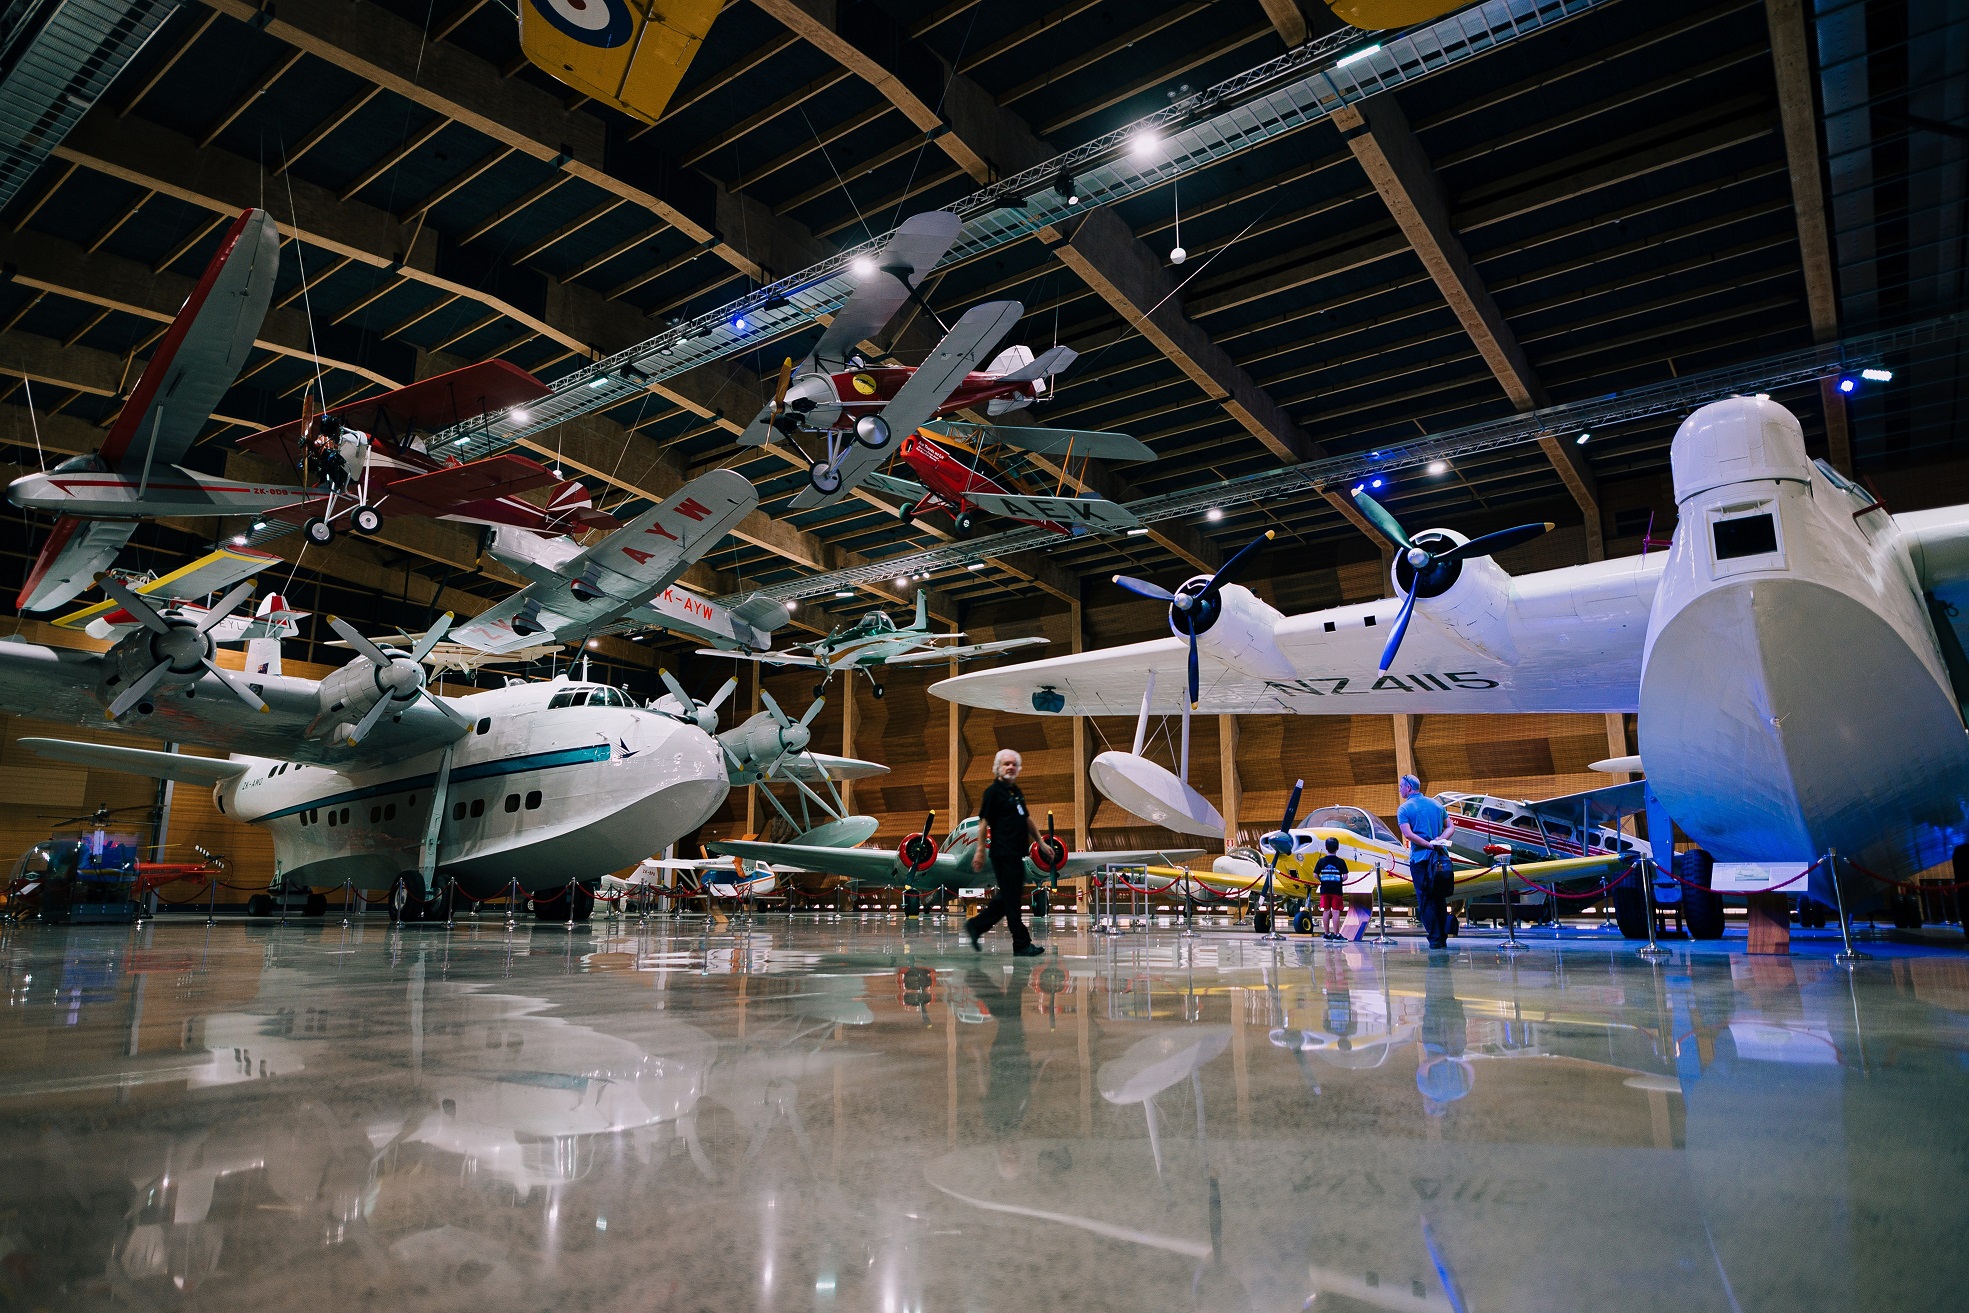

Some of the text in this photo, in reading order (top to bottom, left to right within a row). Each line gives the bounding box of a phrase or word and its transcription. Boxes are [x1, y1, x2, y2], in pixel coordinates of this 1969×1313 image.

[1000, 498, 1109, 522] AEK
[621, 497, 713, 566] AYW
[656, 588, 713, 620] K-AYW
[1264, 671, 1500, 697] NZ4115
